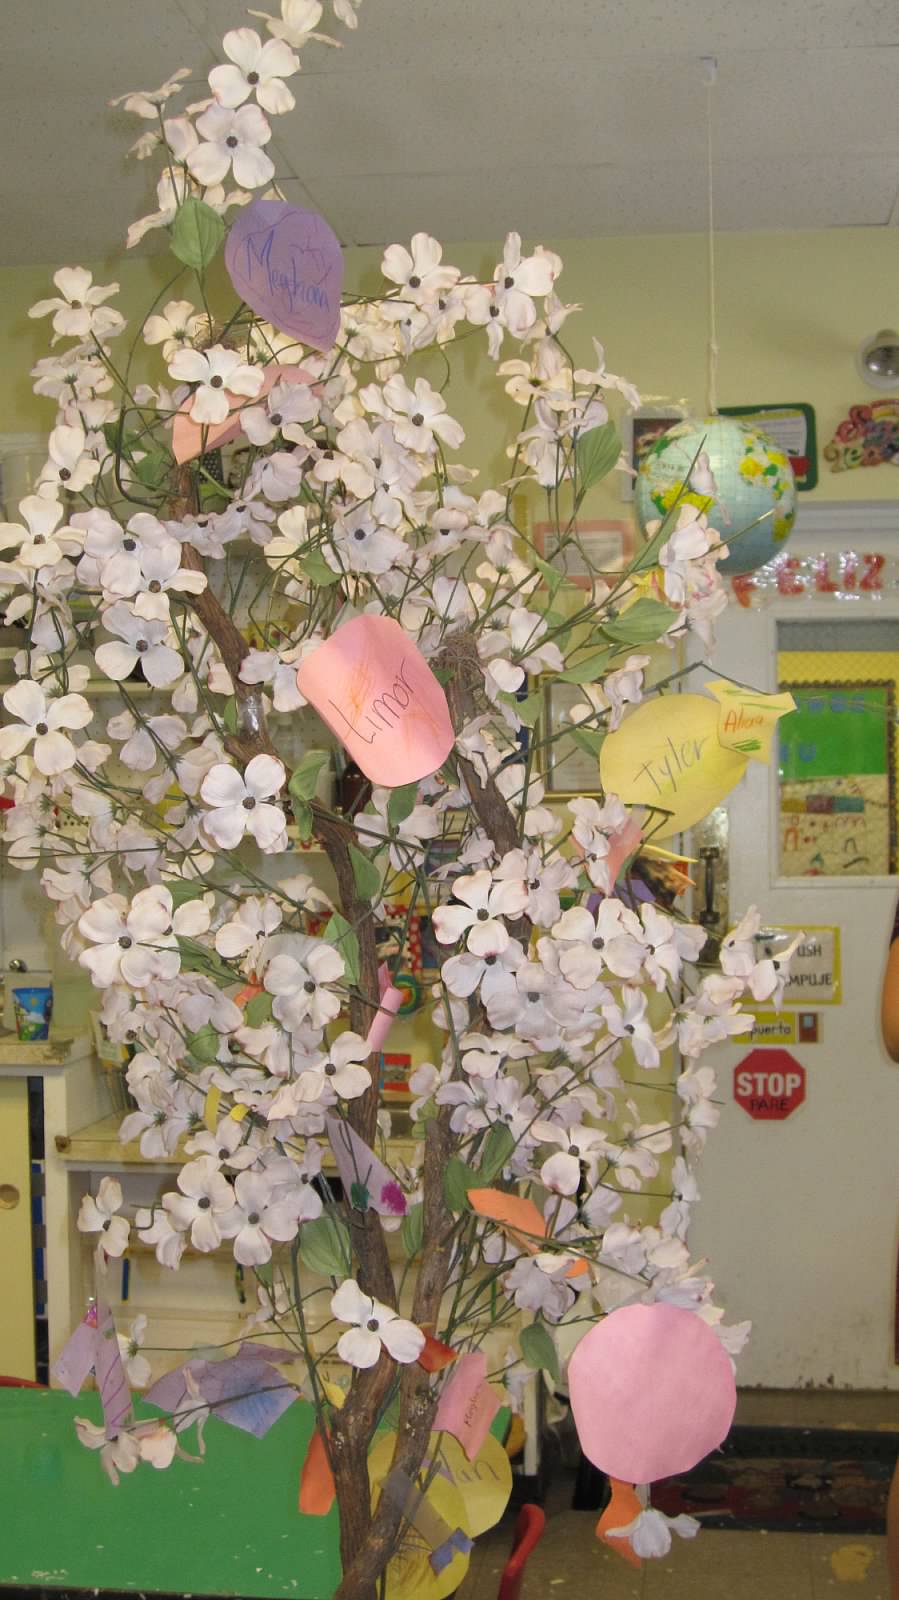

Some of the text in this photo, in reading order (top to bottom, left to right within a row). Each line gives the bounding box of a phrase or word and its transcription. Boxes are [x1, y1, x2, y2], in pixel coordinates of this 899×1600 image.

[327, 656, 414, 744] Limor
[633, 735, 708, 794] Tyler
[797, 943, 822, 957] USH
[784, 972, 832, 986] MPUJE
[736, 1071, 802, 1097] STOP
[751, 1099, 790, 1111] PARE
